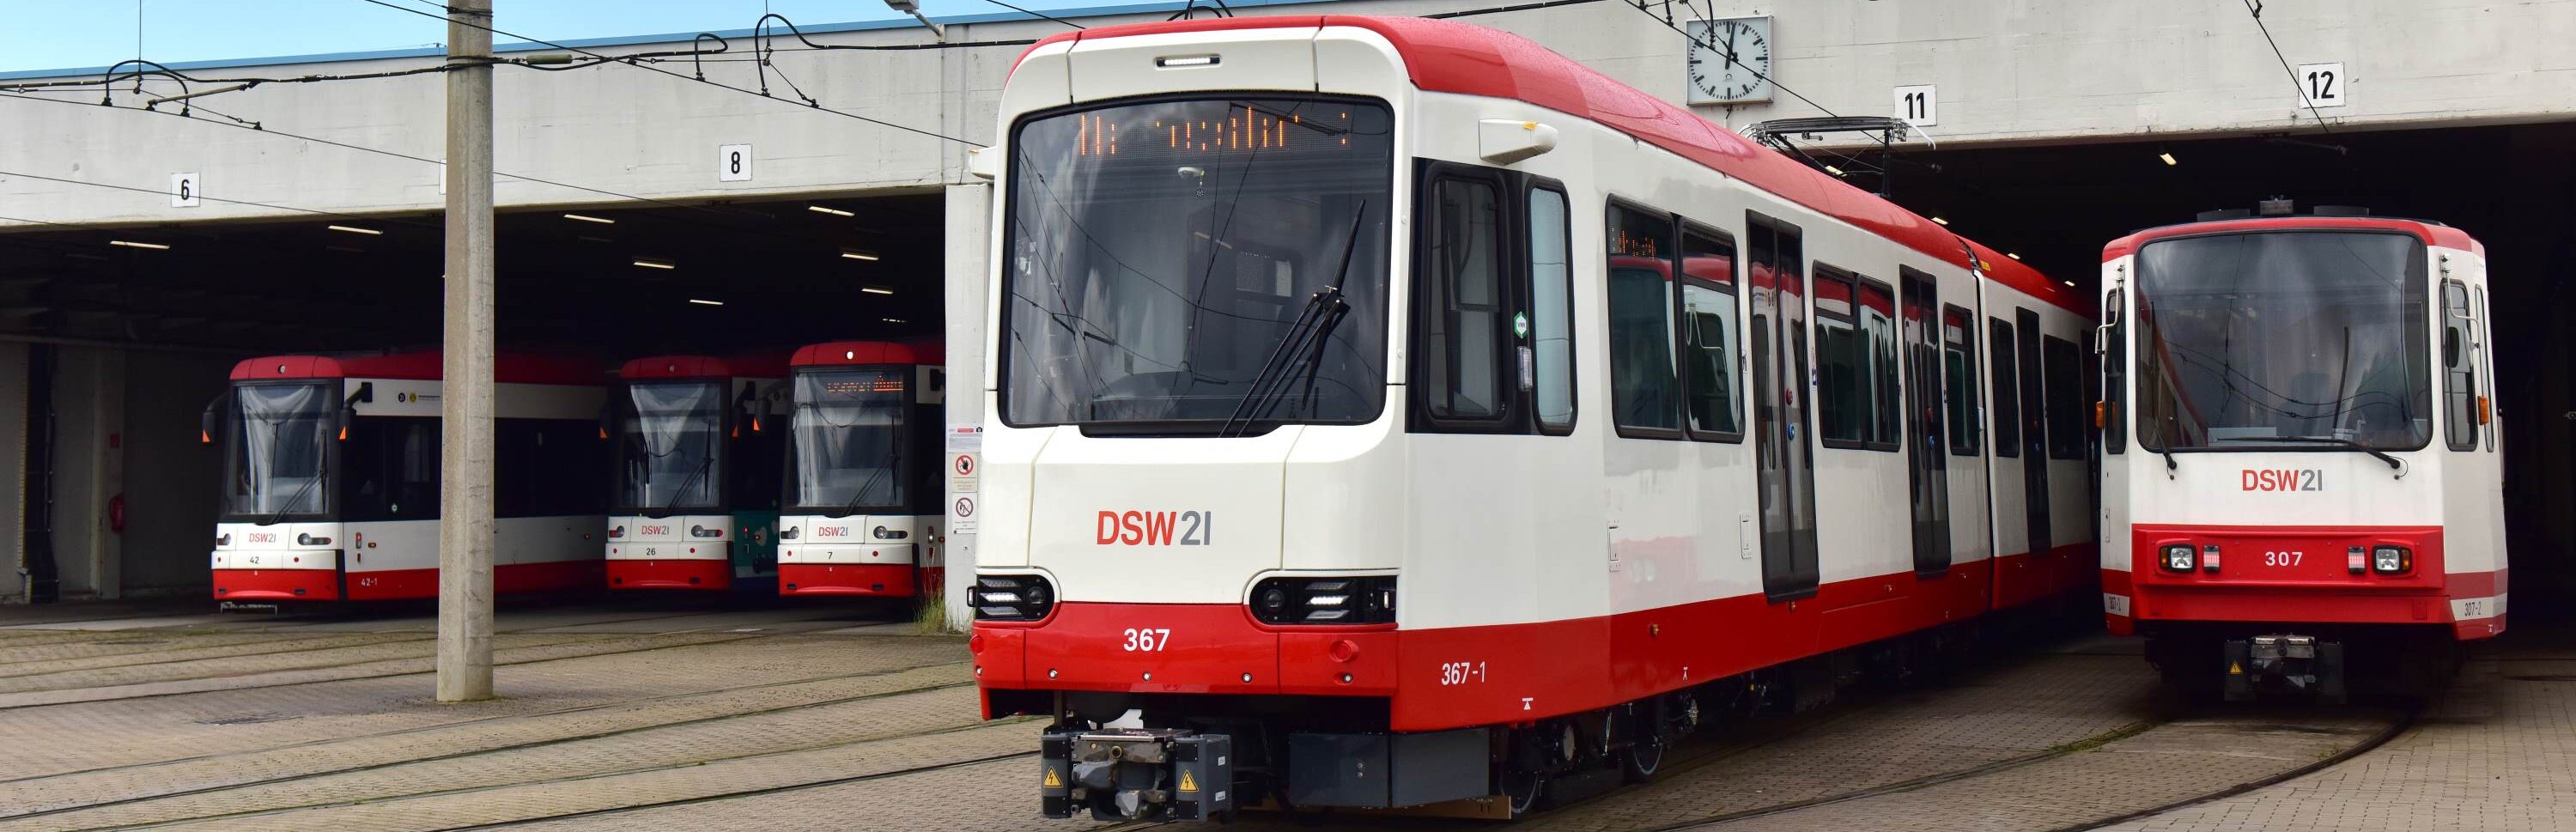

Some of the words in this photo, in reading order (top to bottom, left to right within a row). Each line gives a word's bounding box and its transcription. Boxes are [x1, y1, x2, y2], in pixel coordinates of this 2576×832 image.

[2308, 70, 2335, 100] 12
[1905, 92, 1924, 119] 11
[731, 151, 741, 174] 8
[181, 179, 190, 200] 6
[2242, 469, 2323, 492] DSW21
[641, 525, 670, 535] DSW21
[818, 526, 848, 537] DSW21
[1097, 510, 1212, 546] DSW21
[249, 532, 276, 543] DSW21
[249, 556, 259, 564] 42
[827, 551, 833, 560] 7
[2265, 551, 2303, 567] 307
[361, 578, 378, 586] 42-1
[2464, 601, 2482, 616] 307-2
[1123, 628, 1170, 652] 367
[1441, 660, 1485, 686] 367-1
